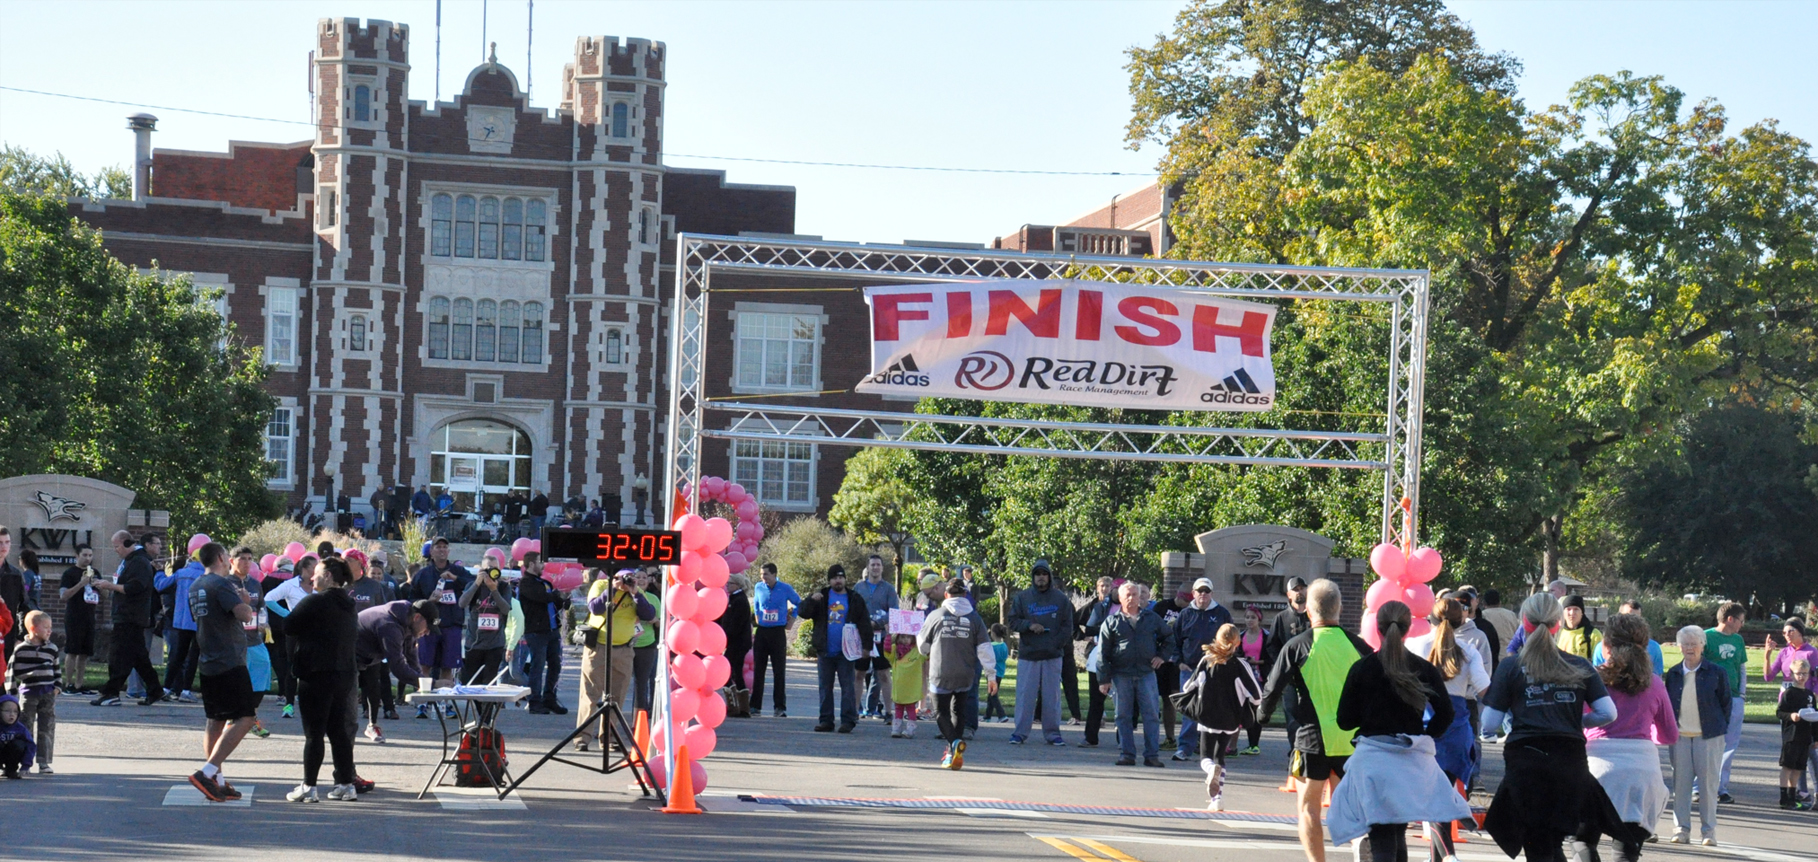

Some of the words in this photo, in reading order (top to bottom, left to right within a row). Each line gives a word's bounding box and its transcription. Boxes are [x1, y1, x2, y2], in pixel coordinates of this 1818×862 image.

[872, 289, 1269, 358] FINISH
[1060, 384, 1083, 392] Race
[1085, 385, 1149, 396] Management
[1200, 390, 1270, 405] adidas
[20, 527, 93, 550] KWU
[481, 618, 496, 627] 233
